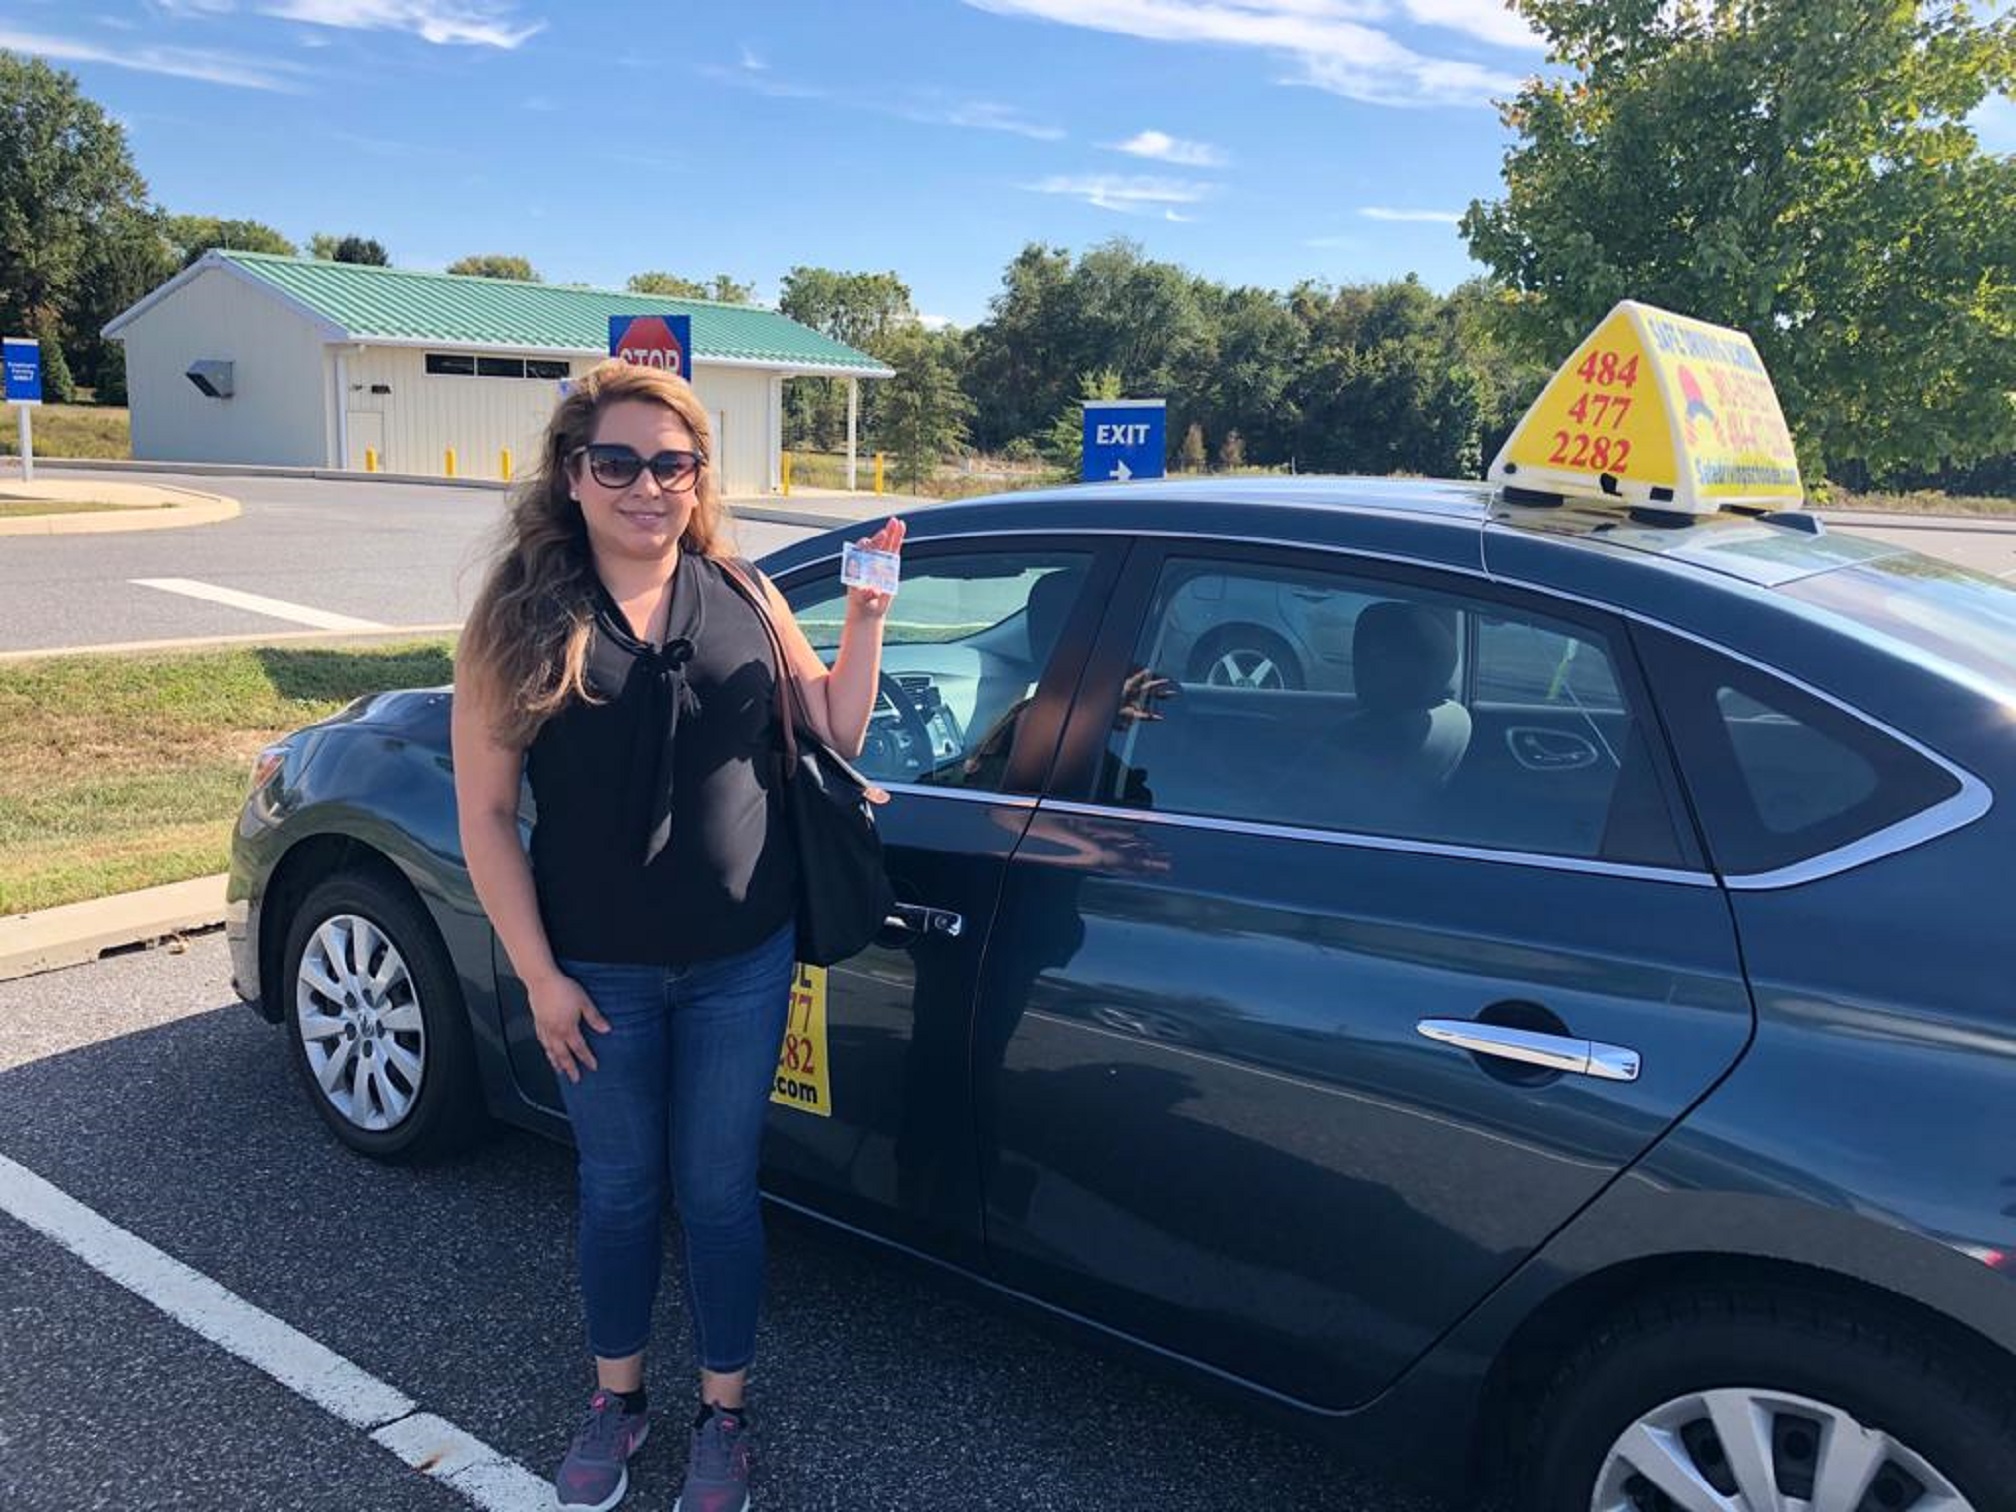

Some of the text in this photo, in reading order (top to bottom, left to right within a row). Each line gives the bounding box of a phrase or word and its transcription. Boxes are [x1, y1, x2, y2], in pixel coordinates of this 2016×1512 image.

[1578, 350, 1638, 388] 484
[1568, 393, 1632, 429] 477
[1096, 423, 1151, 445] EXIT
[1549, 431, 1631, 473] 2282
[779, 1033, 814, 1074] 82
